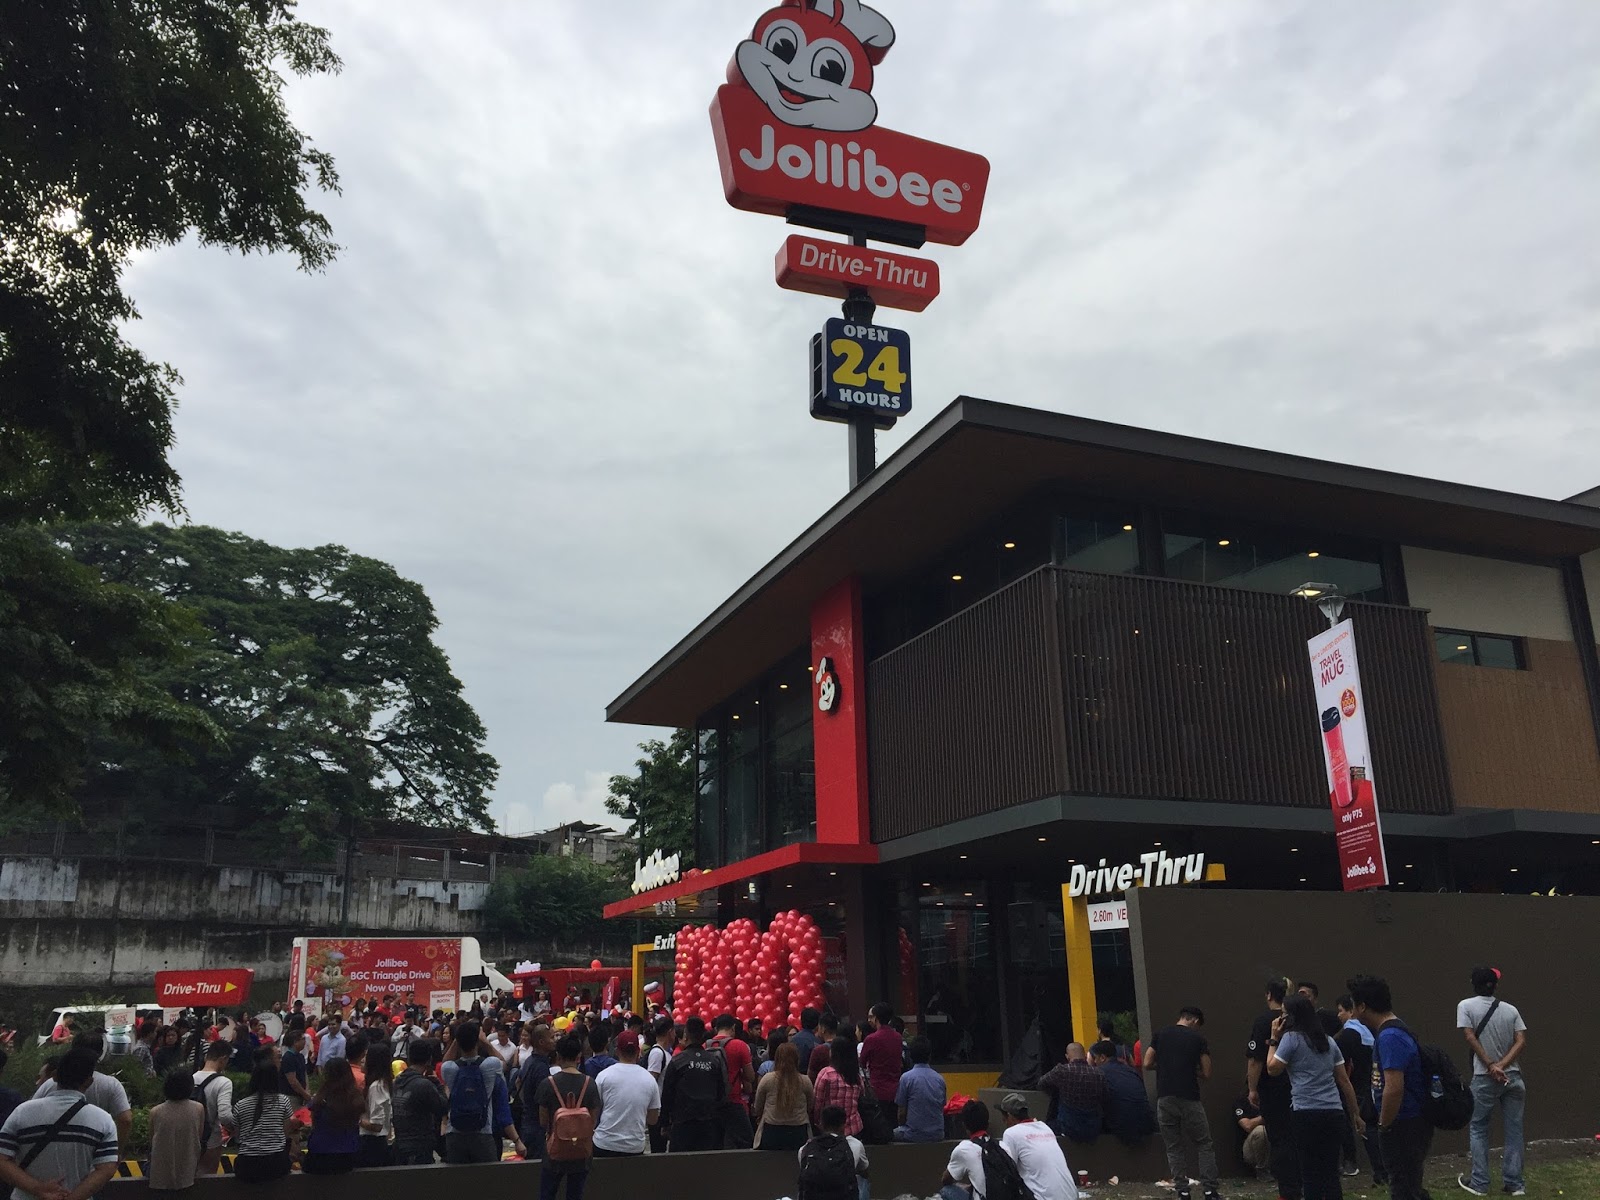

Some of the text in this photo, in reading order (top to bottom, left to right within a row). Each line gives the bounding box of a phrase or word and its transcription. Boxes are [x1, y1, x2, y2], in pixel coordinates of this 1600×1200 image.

[739, 124, 963, 213] Jollibee
[800, 243, 928, 289] Drive-Thru
[843, 324, 889, 343] OPEN
[830, 338, 907, 393] 24
[839, 388, 901, 409] HOURS
[1319, 648, 1342, 671] TRAVEL
[1321, 659, 1345, 688] MUG
[1352, 808, 1364, 819] P75
[1068, 850, 1205, 897] Drive-Thru
[1346, 863, 1370, 878] Jollibee
[1093, 907, 1128, 922] 2.60m VE
[653, 932, 676, 950] Exit
[374, 958, 409, 968] Jollibee
[350, 970, 431, 982] BGC Triangle Drive
[163, 982, 221, 996] Drive-Thru
[365, 983, 415, 993] Now Open!
